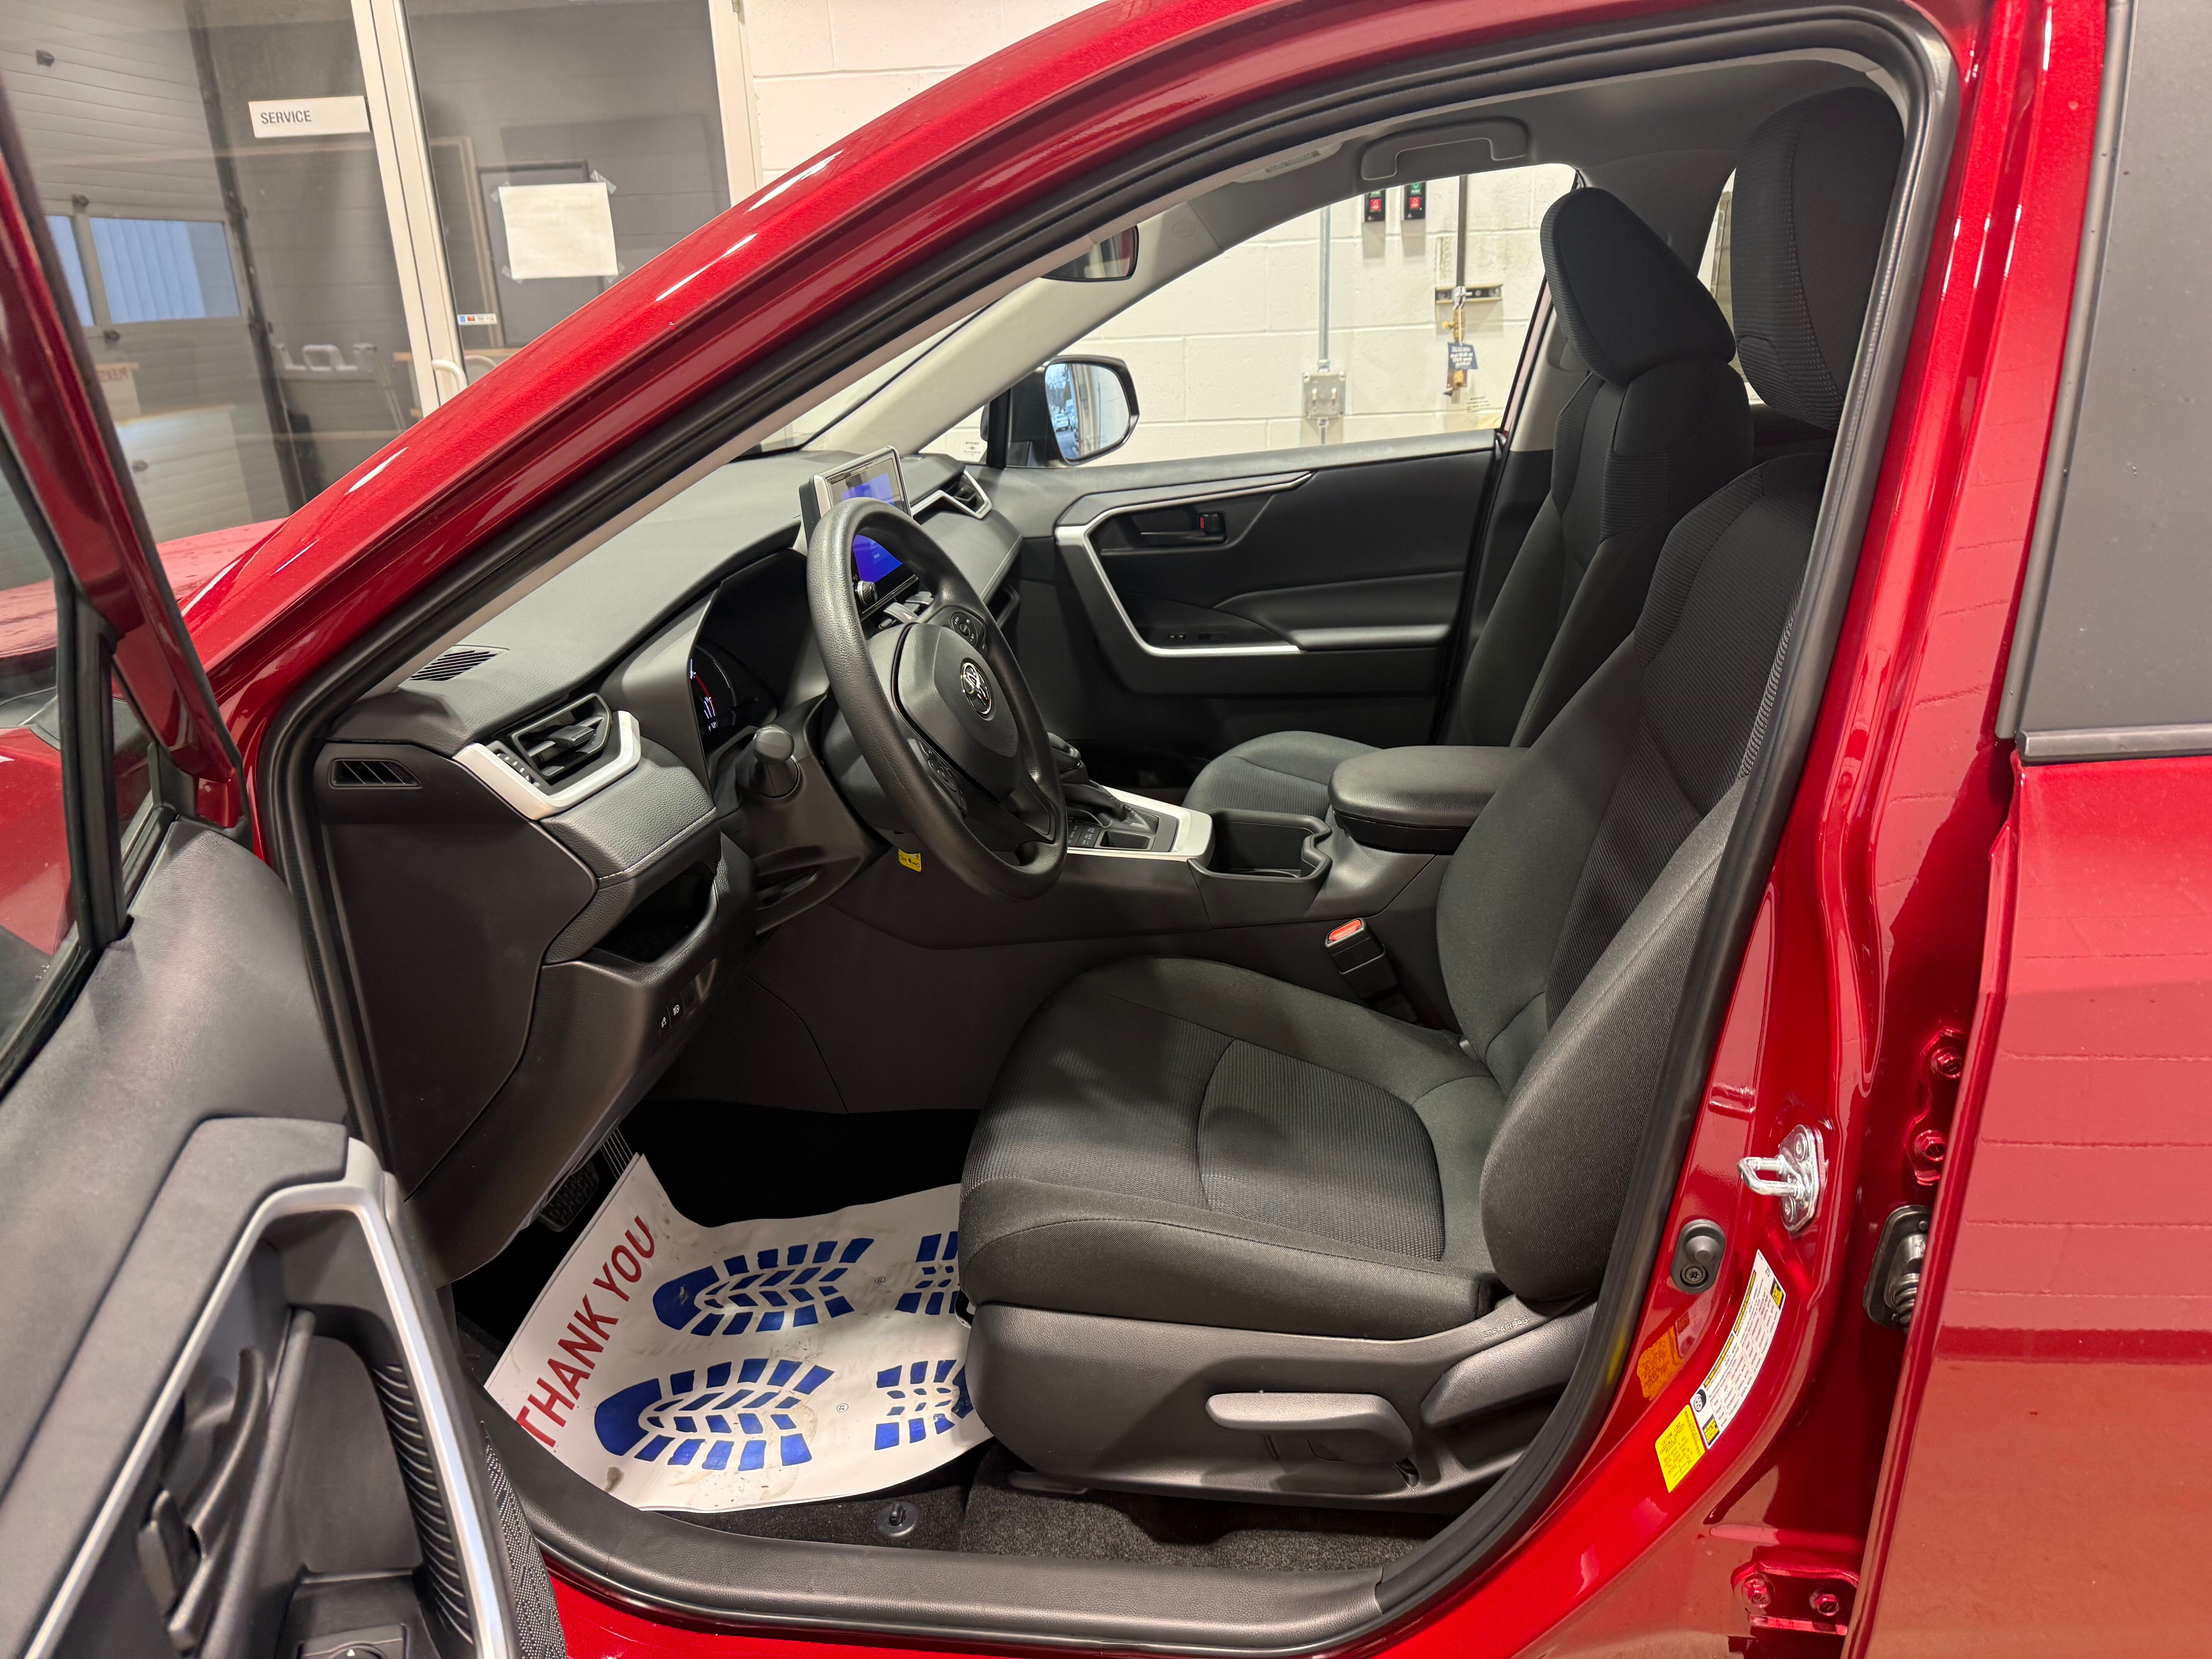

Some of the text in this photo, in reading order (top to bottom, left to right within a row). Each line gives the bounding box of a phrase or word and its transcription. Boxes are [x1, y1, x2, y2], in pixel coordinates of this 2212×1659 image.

[260, 110, 311, 124] SERVICE
[515, 1215, 655, 1448] THANK YOU
[1500, 1317, 1529, 1333] AIRBAG
